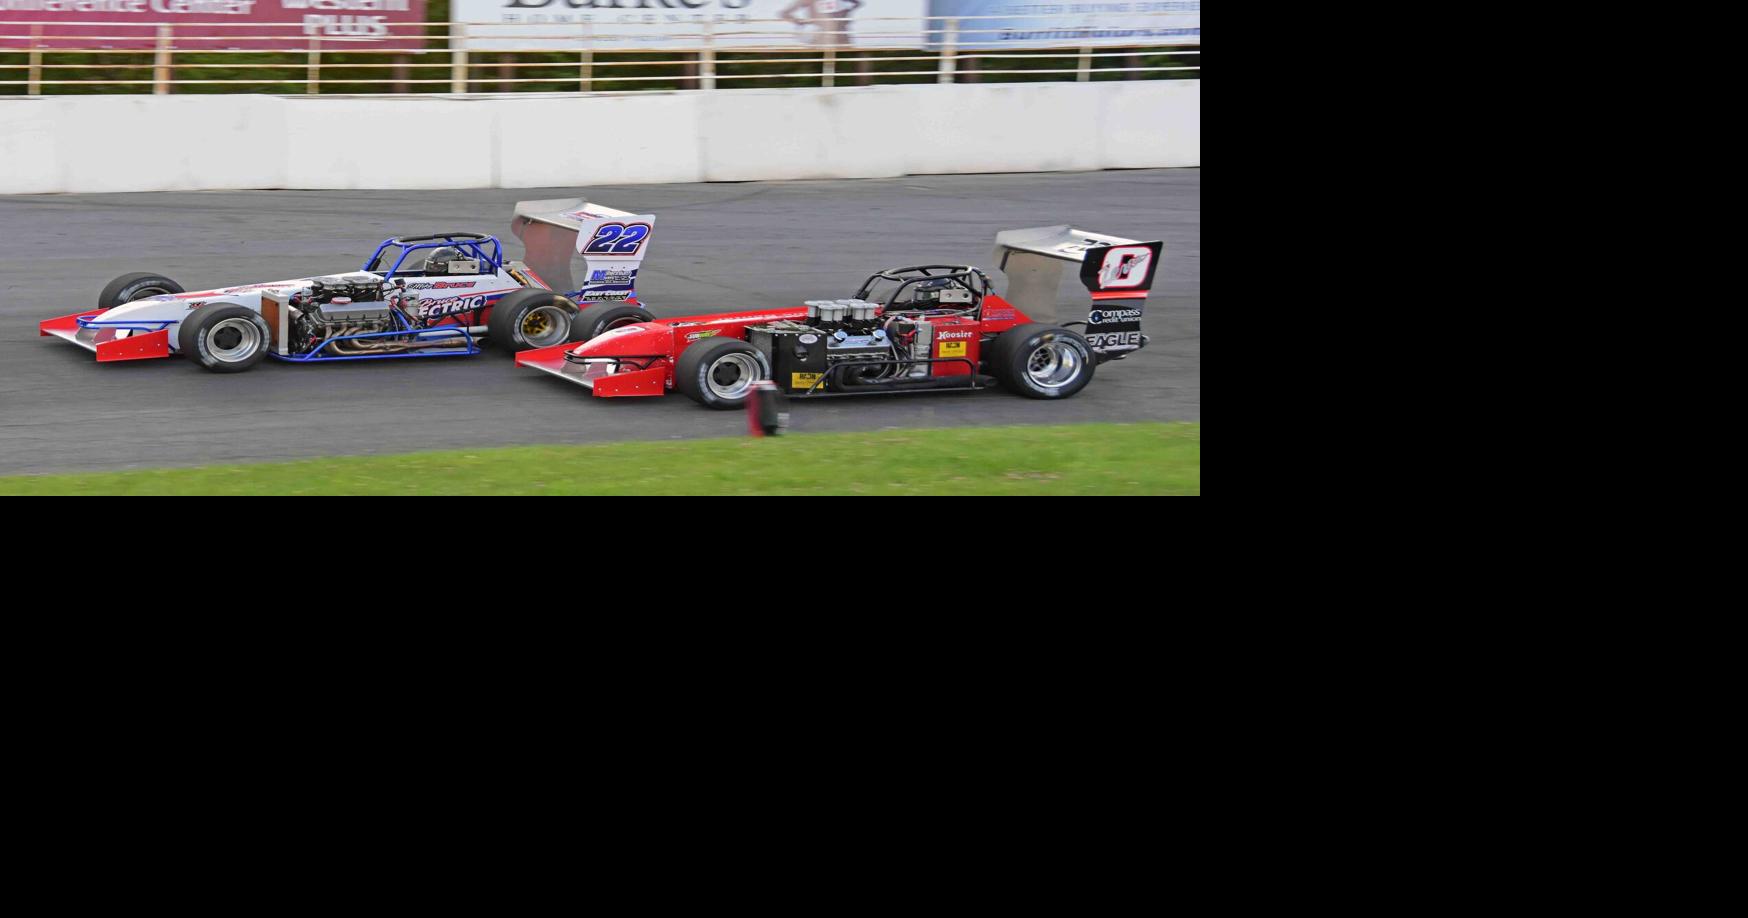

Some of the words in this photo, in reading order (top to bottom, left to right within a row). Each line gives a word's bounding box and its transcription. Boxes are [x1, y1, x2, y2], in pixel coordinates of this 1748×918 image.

[303, 14, 389, 35] PLUS
[502, 14, 594, 24] HOME
[617, 14, 751, 24] CENTER
[582, 222, 651, 256] 22
[1088, 309, 1141, 325] Compass
[936, 330, 974, 340] Hoosier
[1086, 333, 1139, 348] EAGLE
